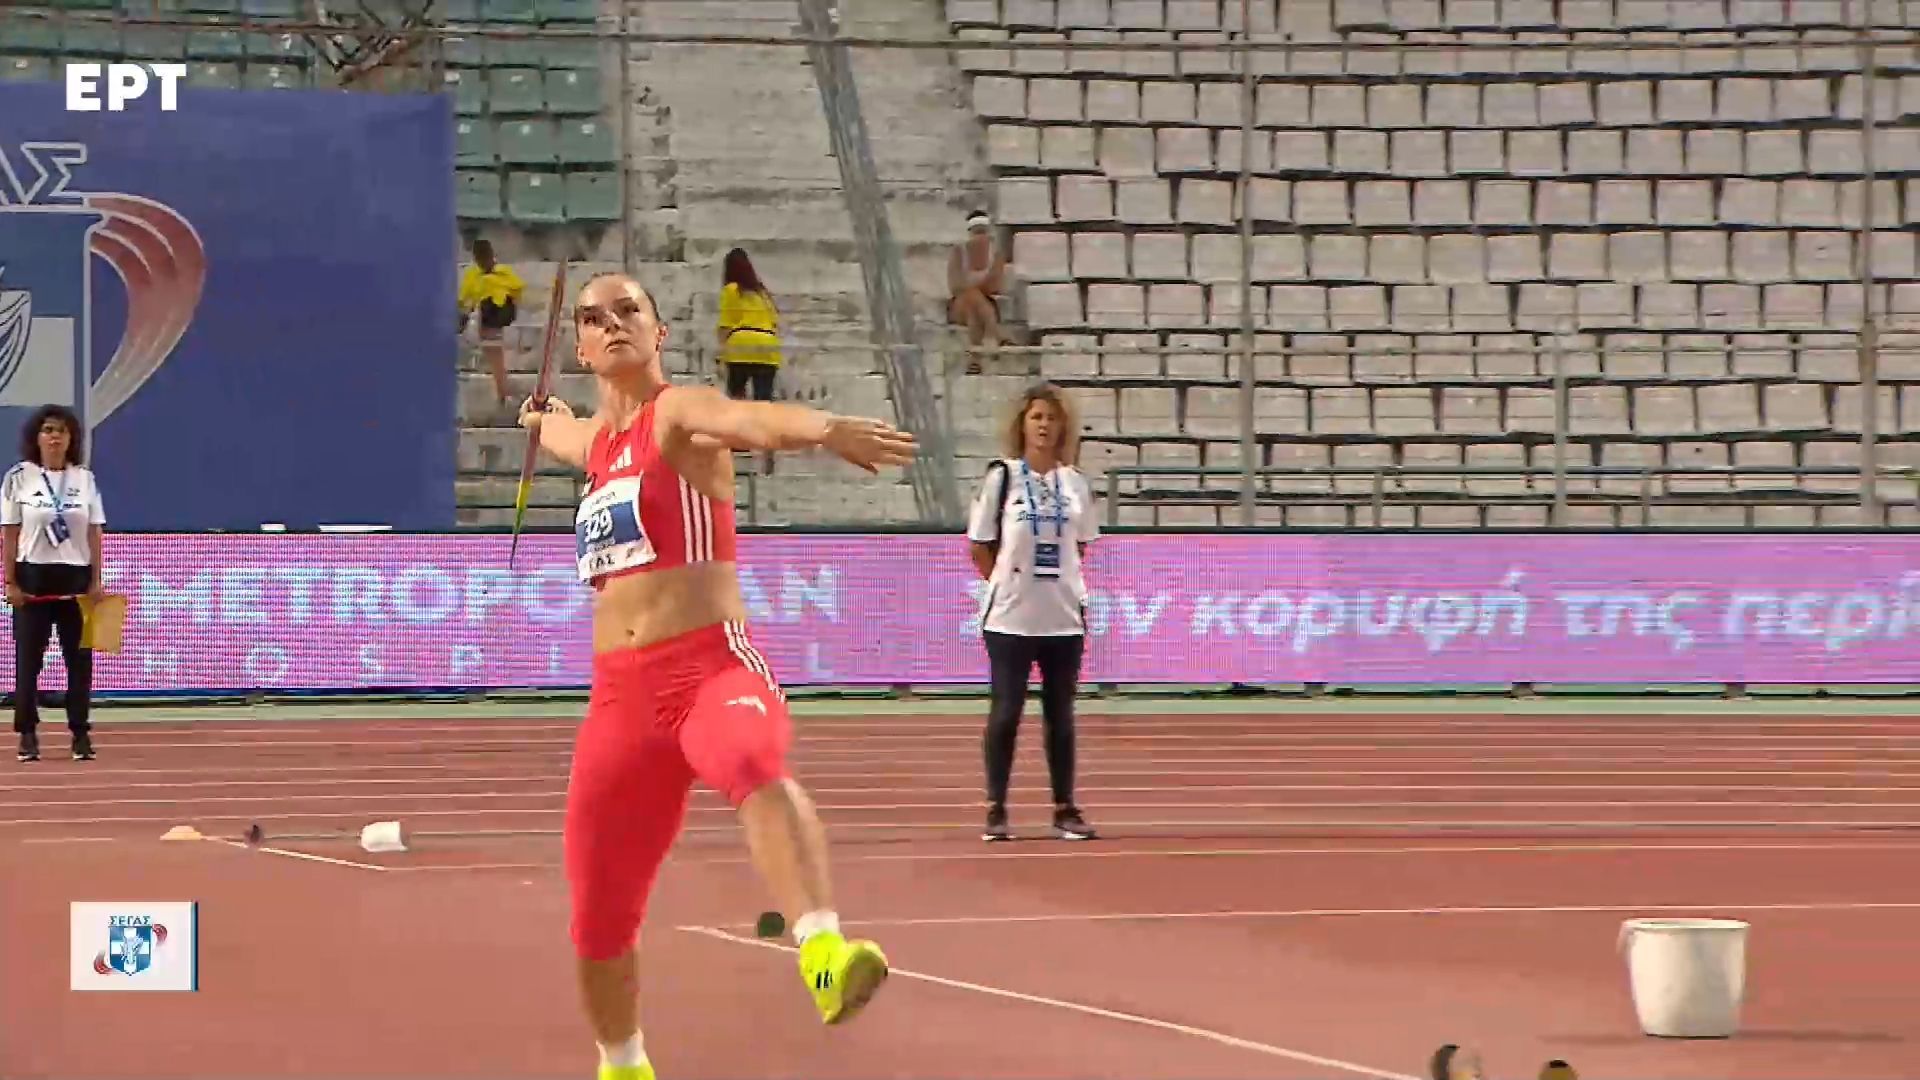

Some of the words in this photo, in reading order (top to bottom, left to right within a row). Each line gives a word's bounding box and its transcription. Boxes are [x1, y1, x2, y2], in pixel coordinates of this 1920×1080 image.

[139, 565, 837, 624] METROPOAN
[1191, 571, 1528, 652] κορυφή
[1556, 591, 1698, 652] της
